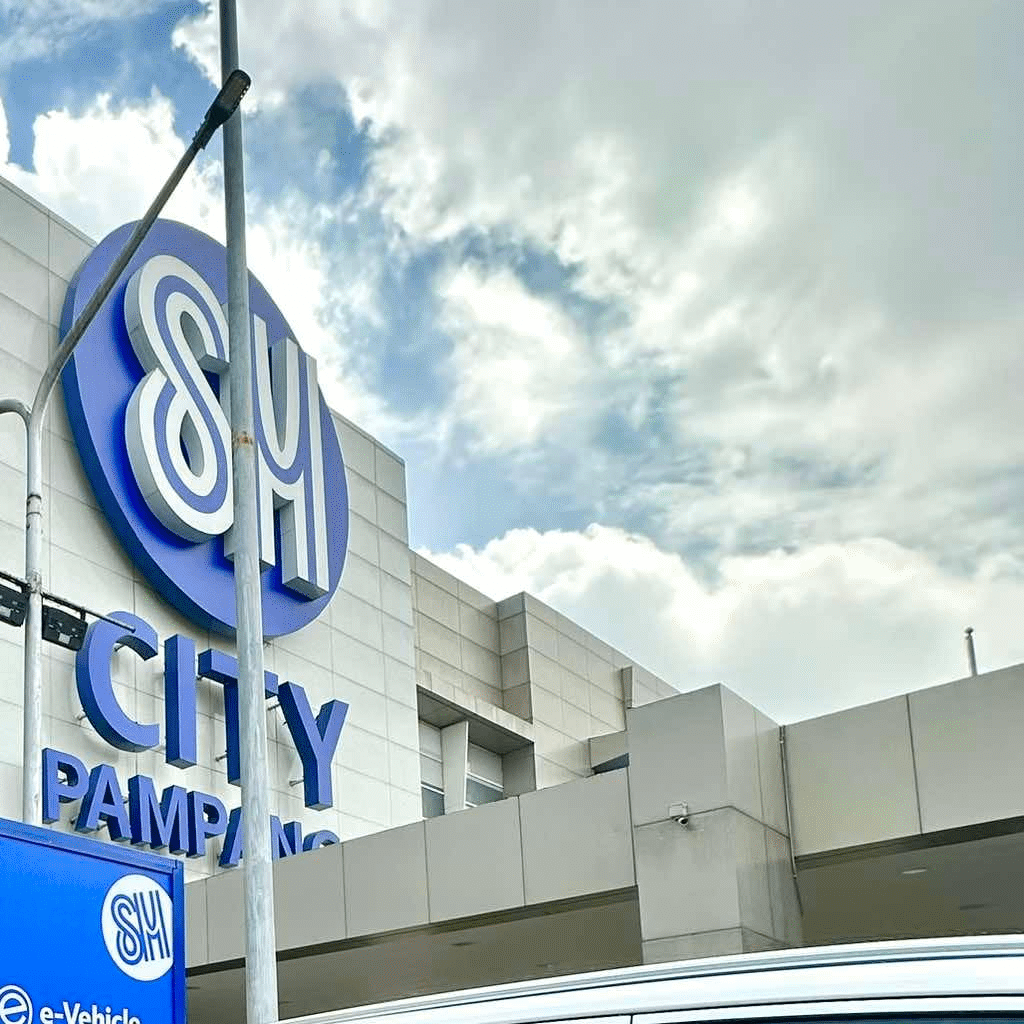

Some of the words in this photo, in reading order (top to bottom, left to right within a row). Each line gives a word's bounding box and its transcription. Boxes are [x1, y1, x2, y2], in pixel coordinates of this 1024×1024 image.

[125, 254, 330, 602] SM
[75, 610, 350, 812] CITY
[110, 889, 171, 966] SM
